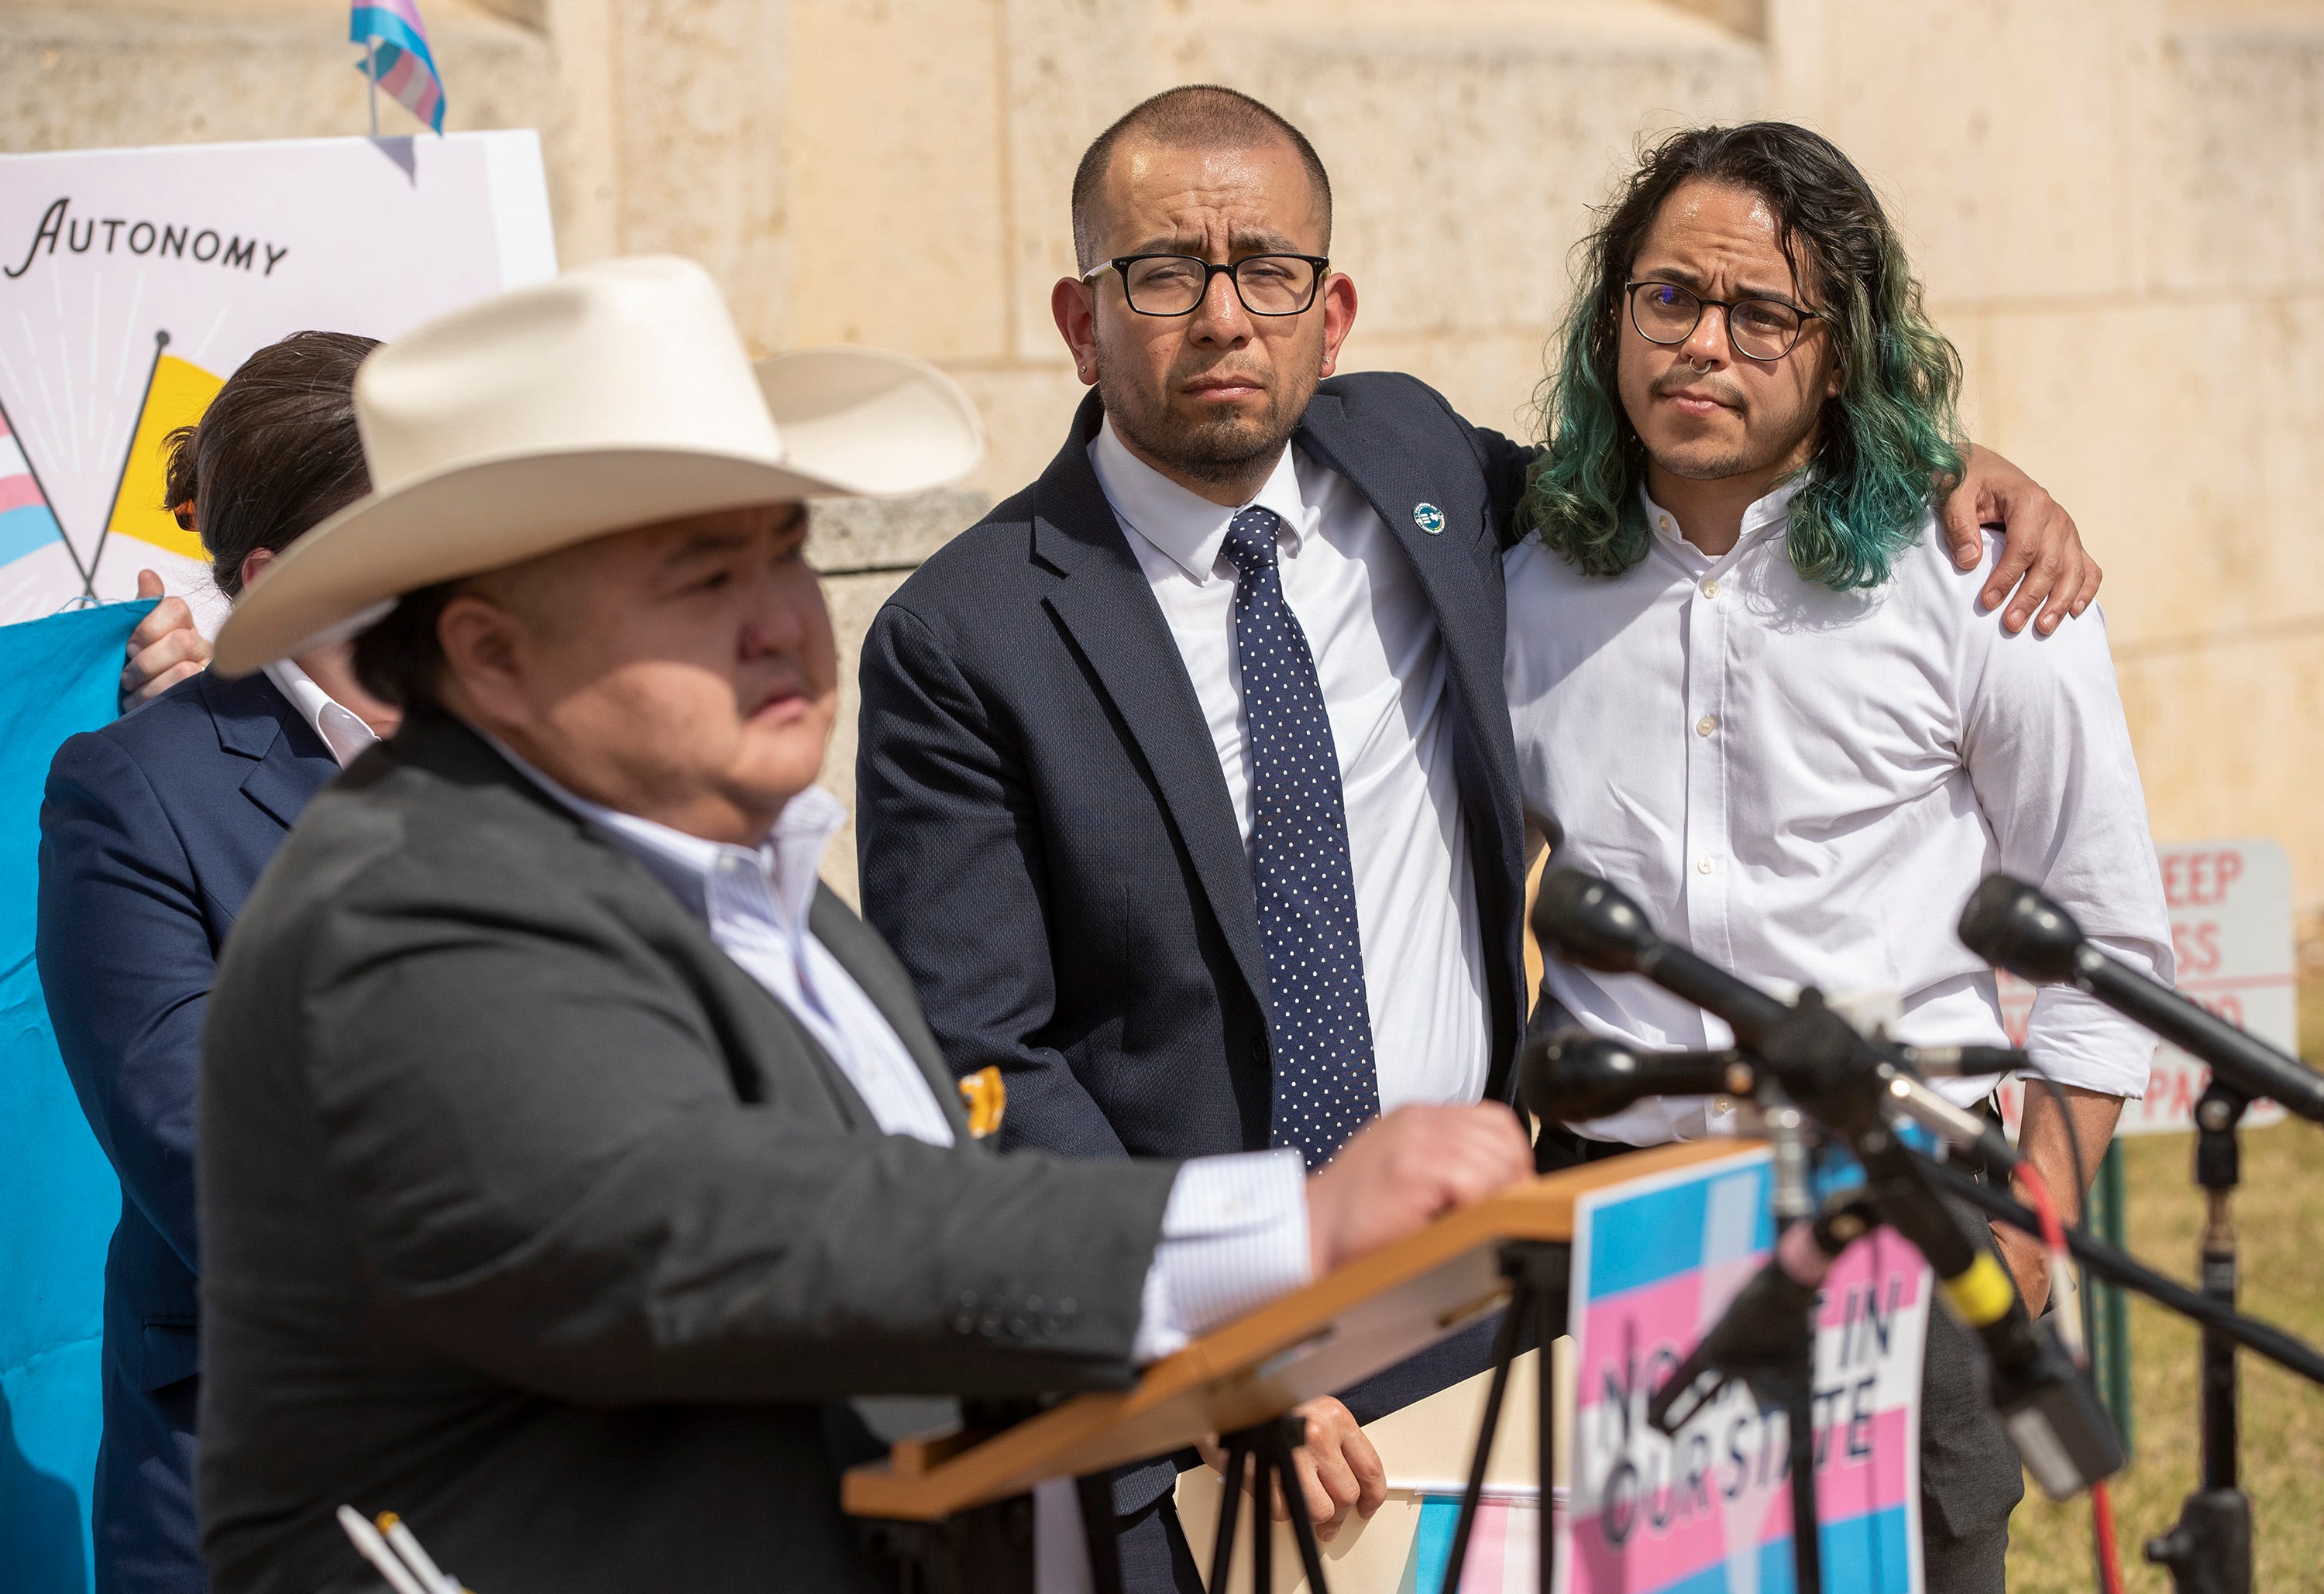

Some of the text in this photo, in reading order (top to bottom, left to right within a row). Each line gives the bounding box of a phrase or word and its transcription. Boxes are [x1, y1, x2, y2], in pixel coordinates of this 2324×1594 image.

[3, 196, 288, 277] AUTONOMY
[2161, 849, 2244, 910] EEP
[1840, 1278, 1903, 1369] IN
[1601, 1434, 1710, 1546] OUR
